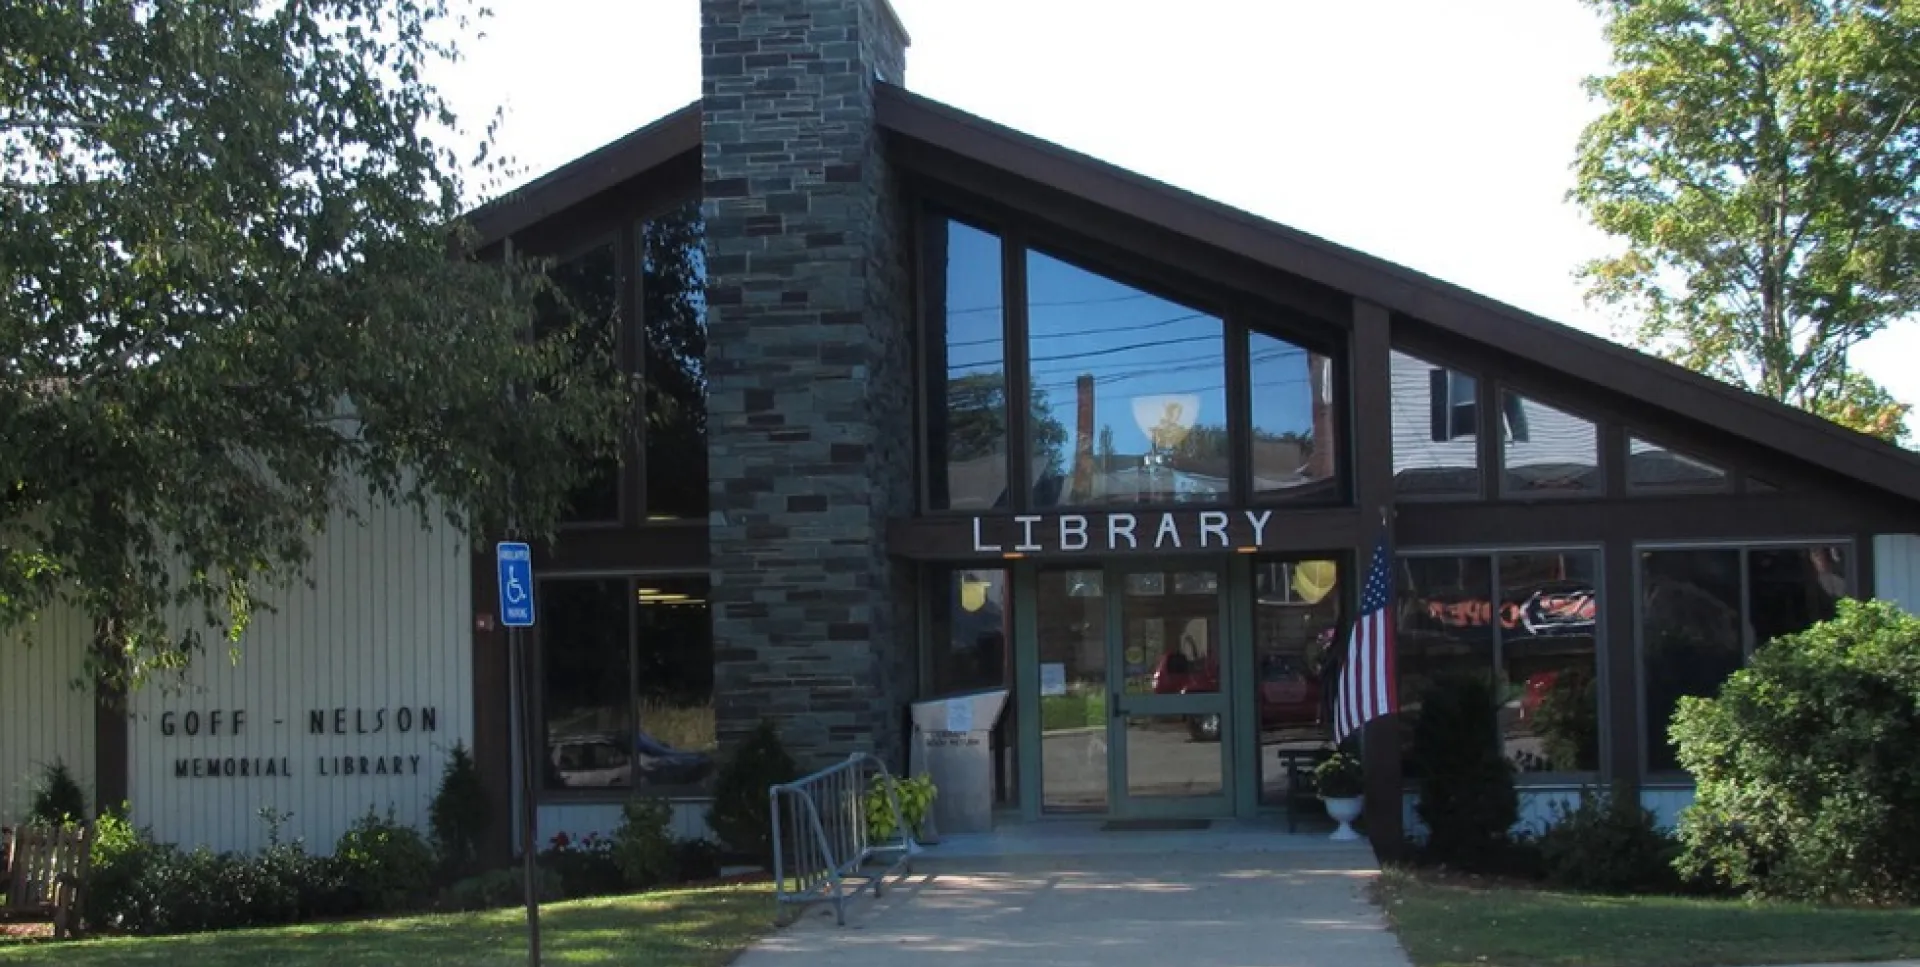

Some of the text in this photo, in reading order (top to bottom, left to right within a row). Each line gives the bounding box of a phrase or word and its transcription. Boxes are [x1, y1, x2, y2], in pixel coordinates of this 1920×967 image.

[973, 511, 1271, 551] LIBRARY
[160, 710, 244, 736] GOFF
[309, 706, 436, 734] NELSON
[174, 754, 420, 778] MEMORIAL LIBRARY
